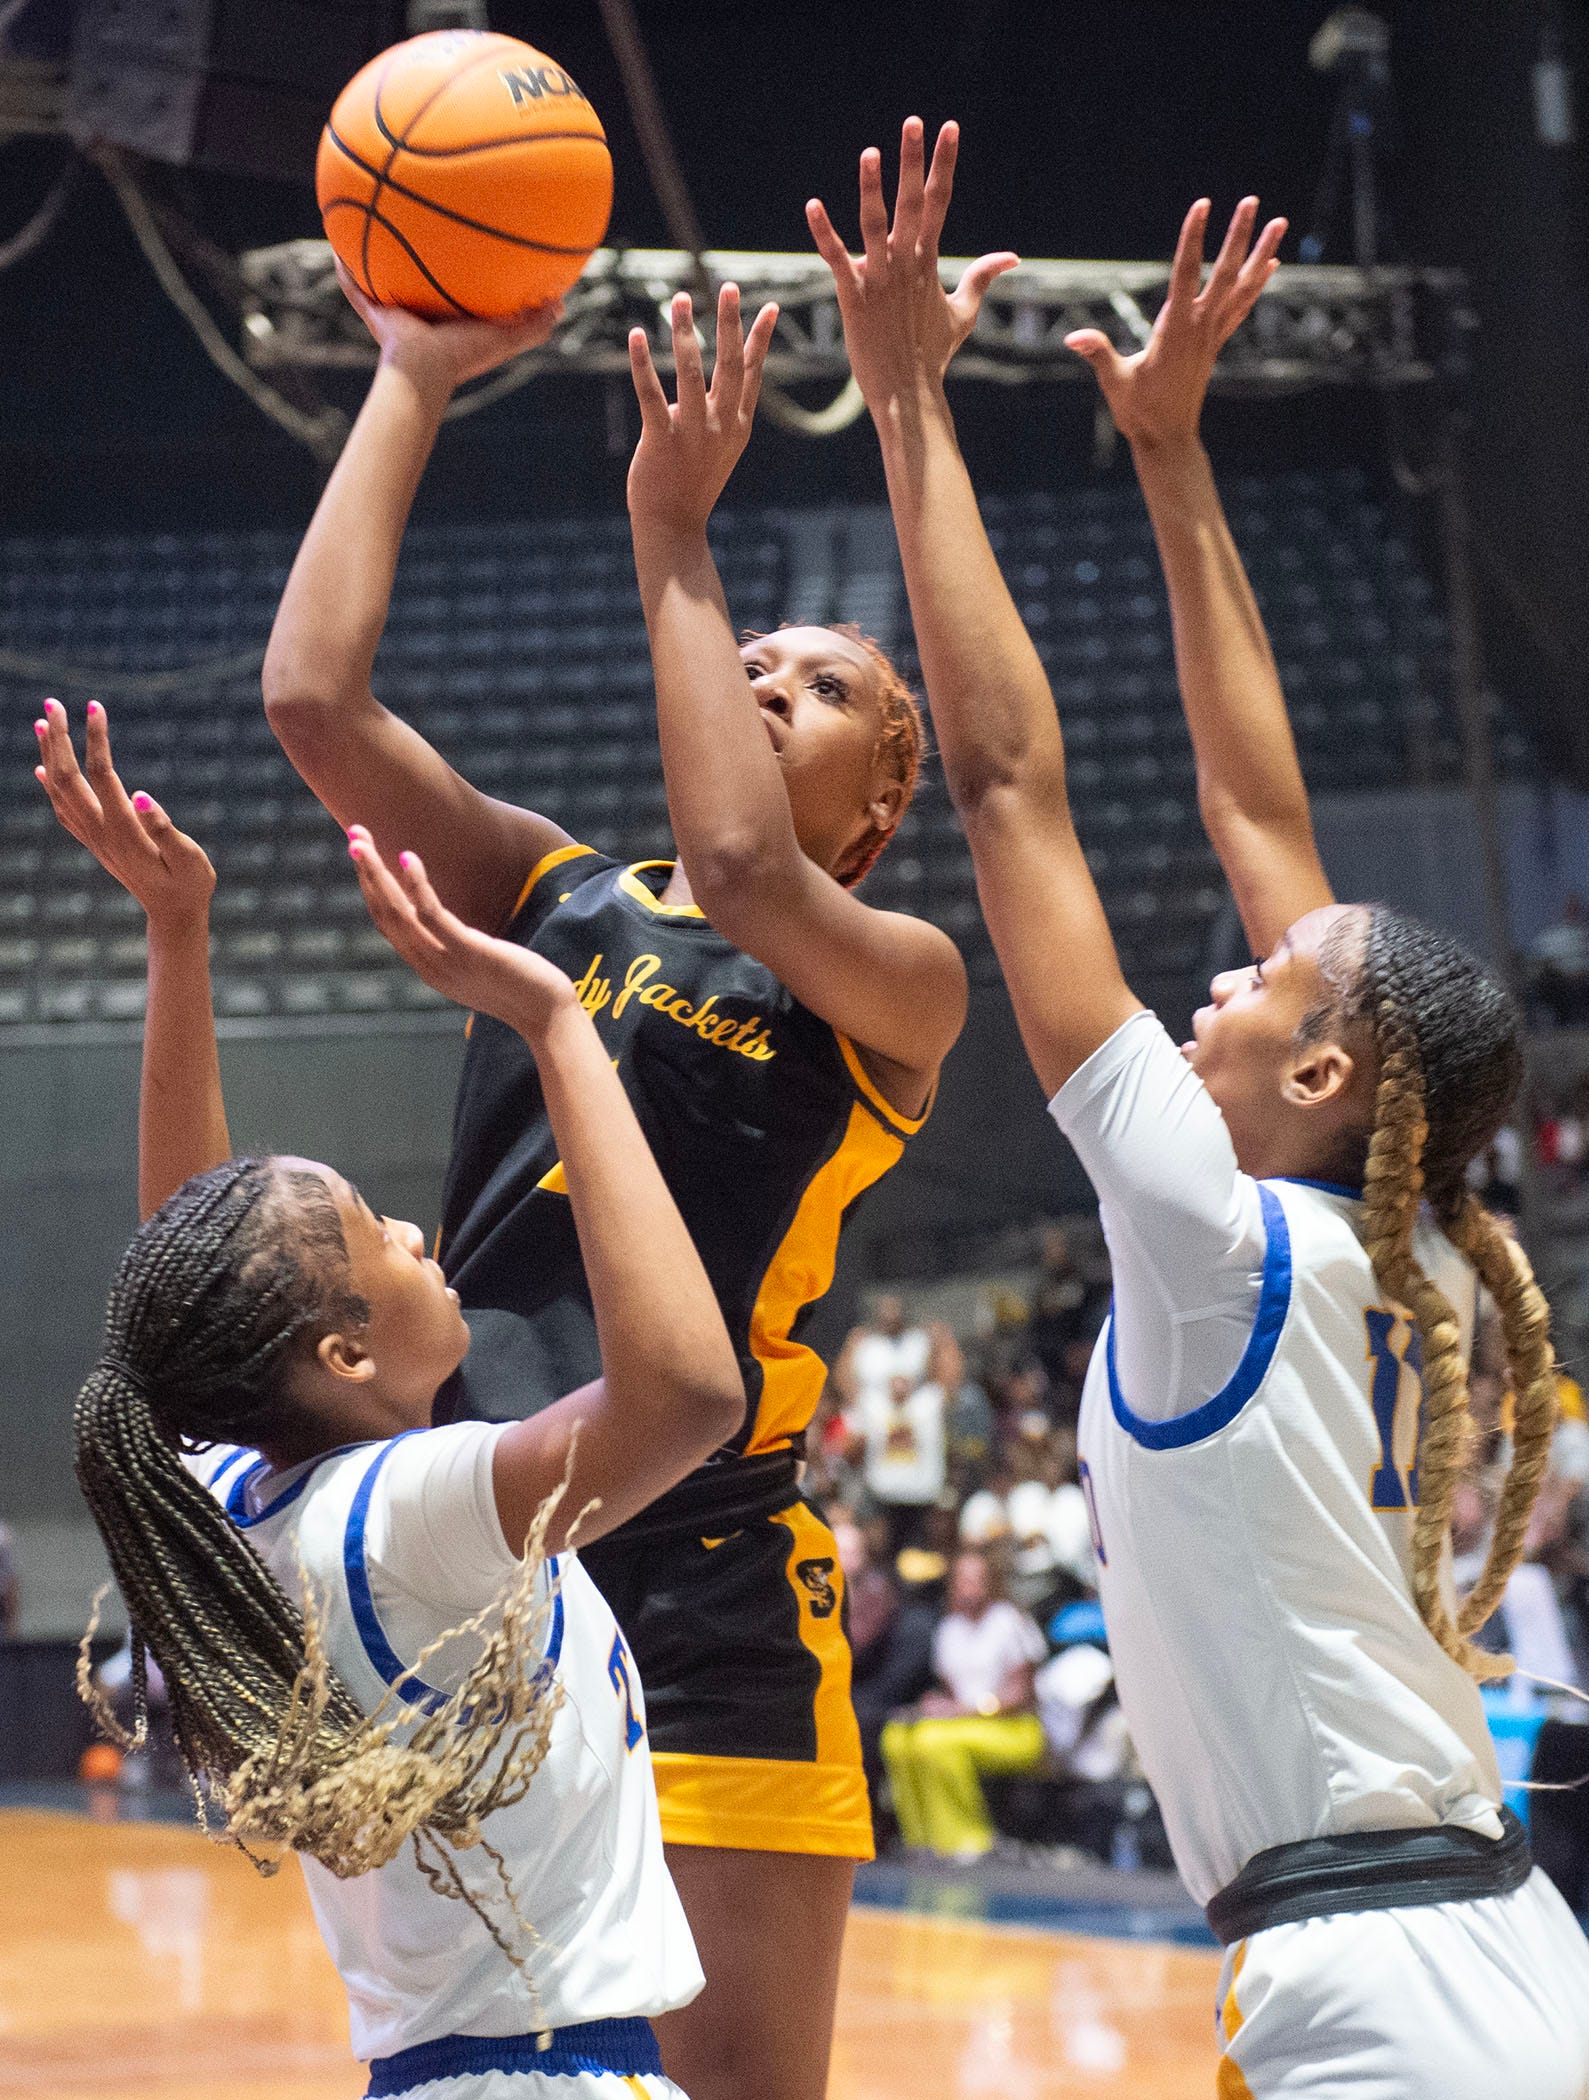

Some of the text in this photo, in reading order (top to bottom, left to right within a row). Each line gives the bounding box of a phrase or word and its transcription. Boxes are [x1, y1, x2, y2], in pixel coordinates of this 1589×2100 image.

[503, 66, 585, 103] NCA
[573, 954, 777, 1061] dy Jackets
